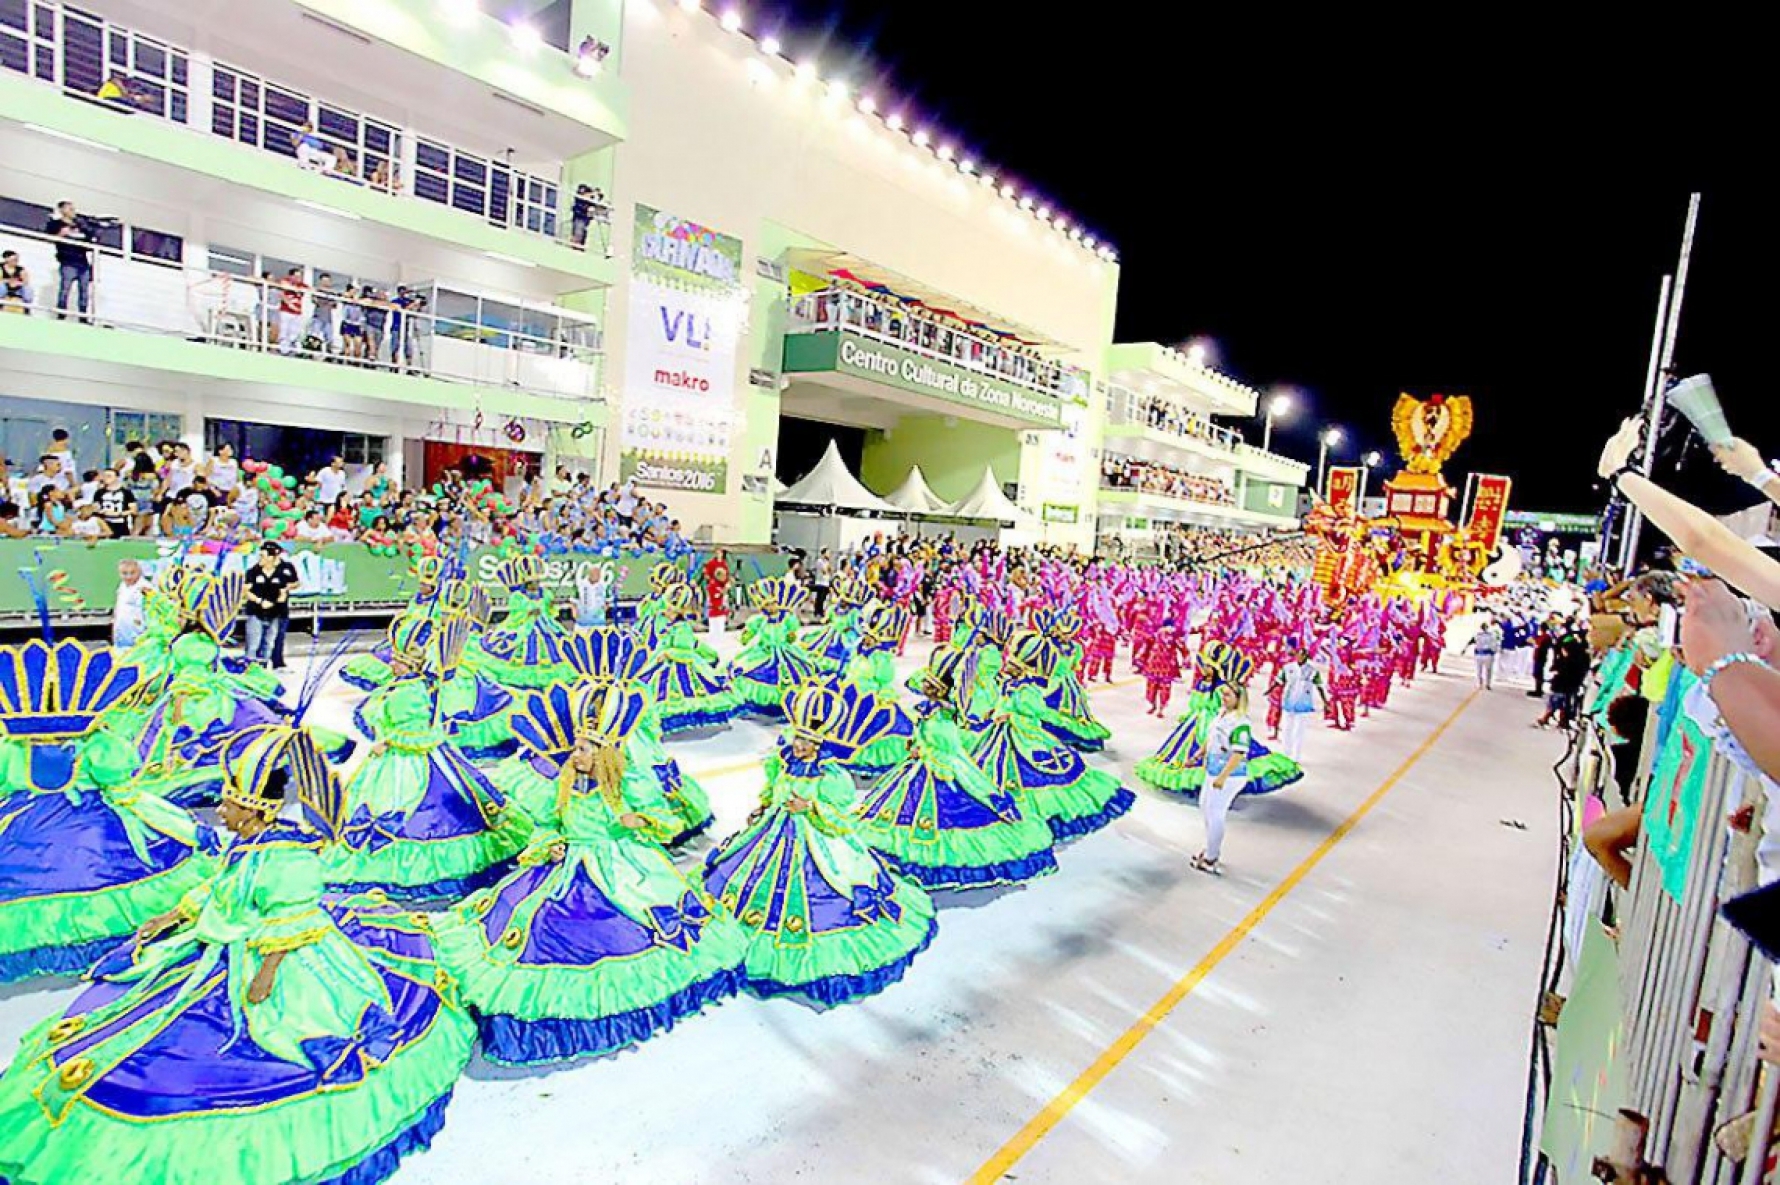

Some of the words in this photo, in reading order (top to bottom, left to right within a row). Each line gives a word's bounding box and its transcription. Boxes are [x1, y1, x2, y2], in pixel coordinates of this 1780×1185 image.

[654, 369, 710, 392] makro
[841, 340, 898, 376] Centro
[901, 358, 960, 393] Cultural
[960, 377, 978, 398] da
[979, 381, 1010, 407] Zona
[758, 448, 772, 469] A
